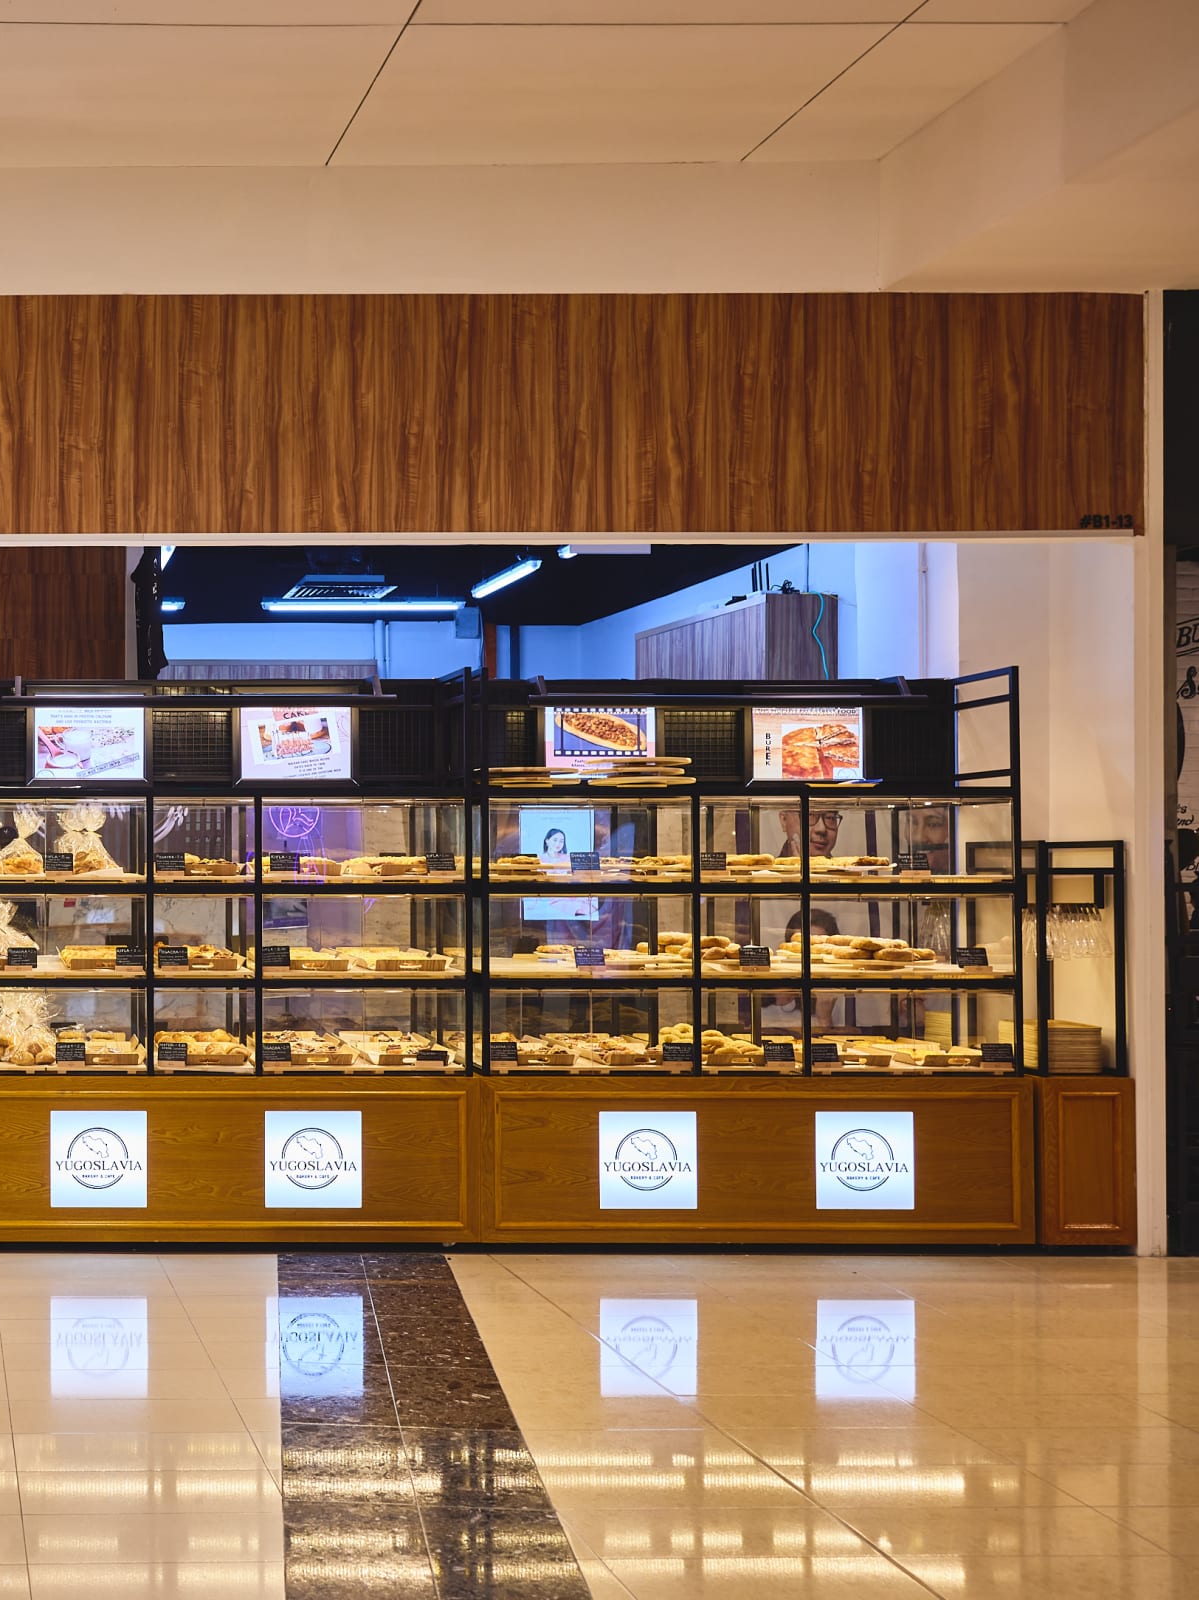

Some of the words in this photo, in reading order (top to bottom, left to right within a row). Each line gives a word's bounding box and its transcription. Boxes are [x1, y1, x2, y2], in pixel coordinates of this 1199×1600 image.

[1080, 514, 1133, 528] #B1-13
[56, 1160, 142, 1171] YUGOSLAVIA
[270, 1160, 356, 1171] YUGOSLAVIA
[604, 1162, 692, 1172] YUGOSLAVIA
[820, 1162, 908, 1172] YUGOSLAVIA
